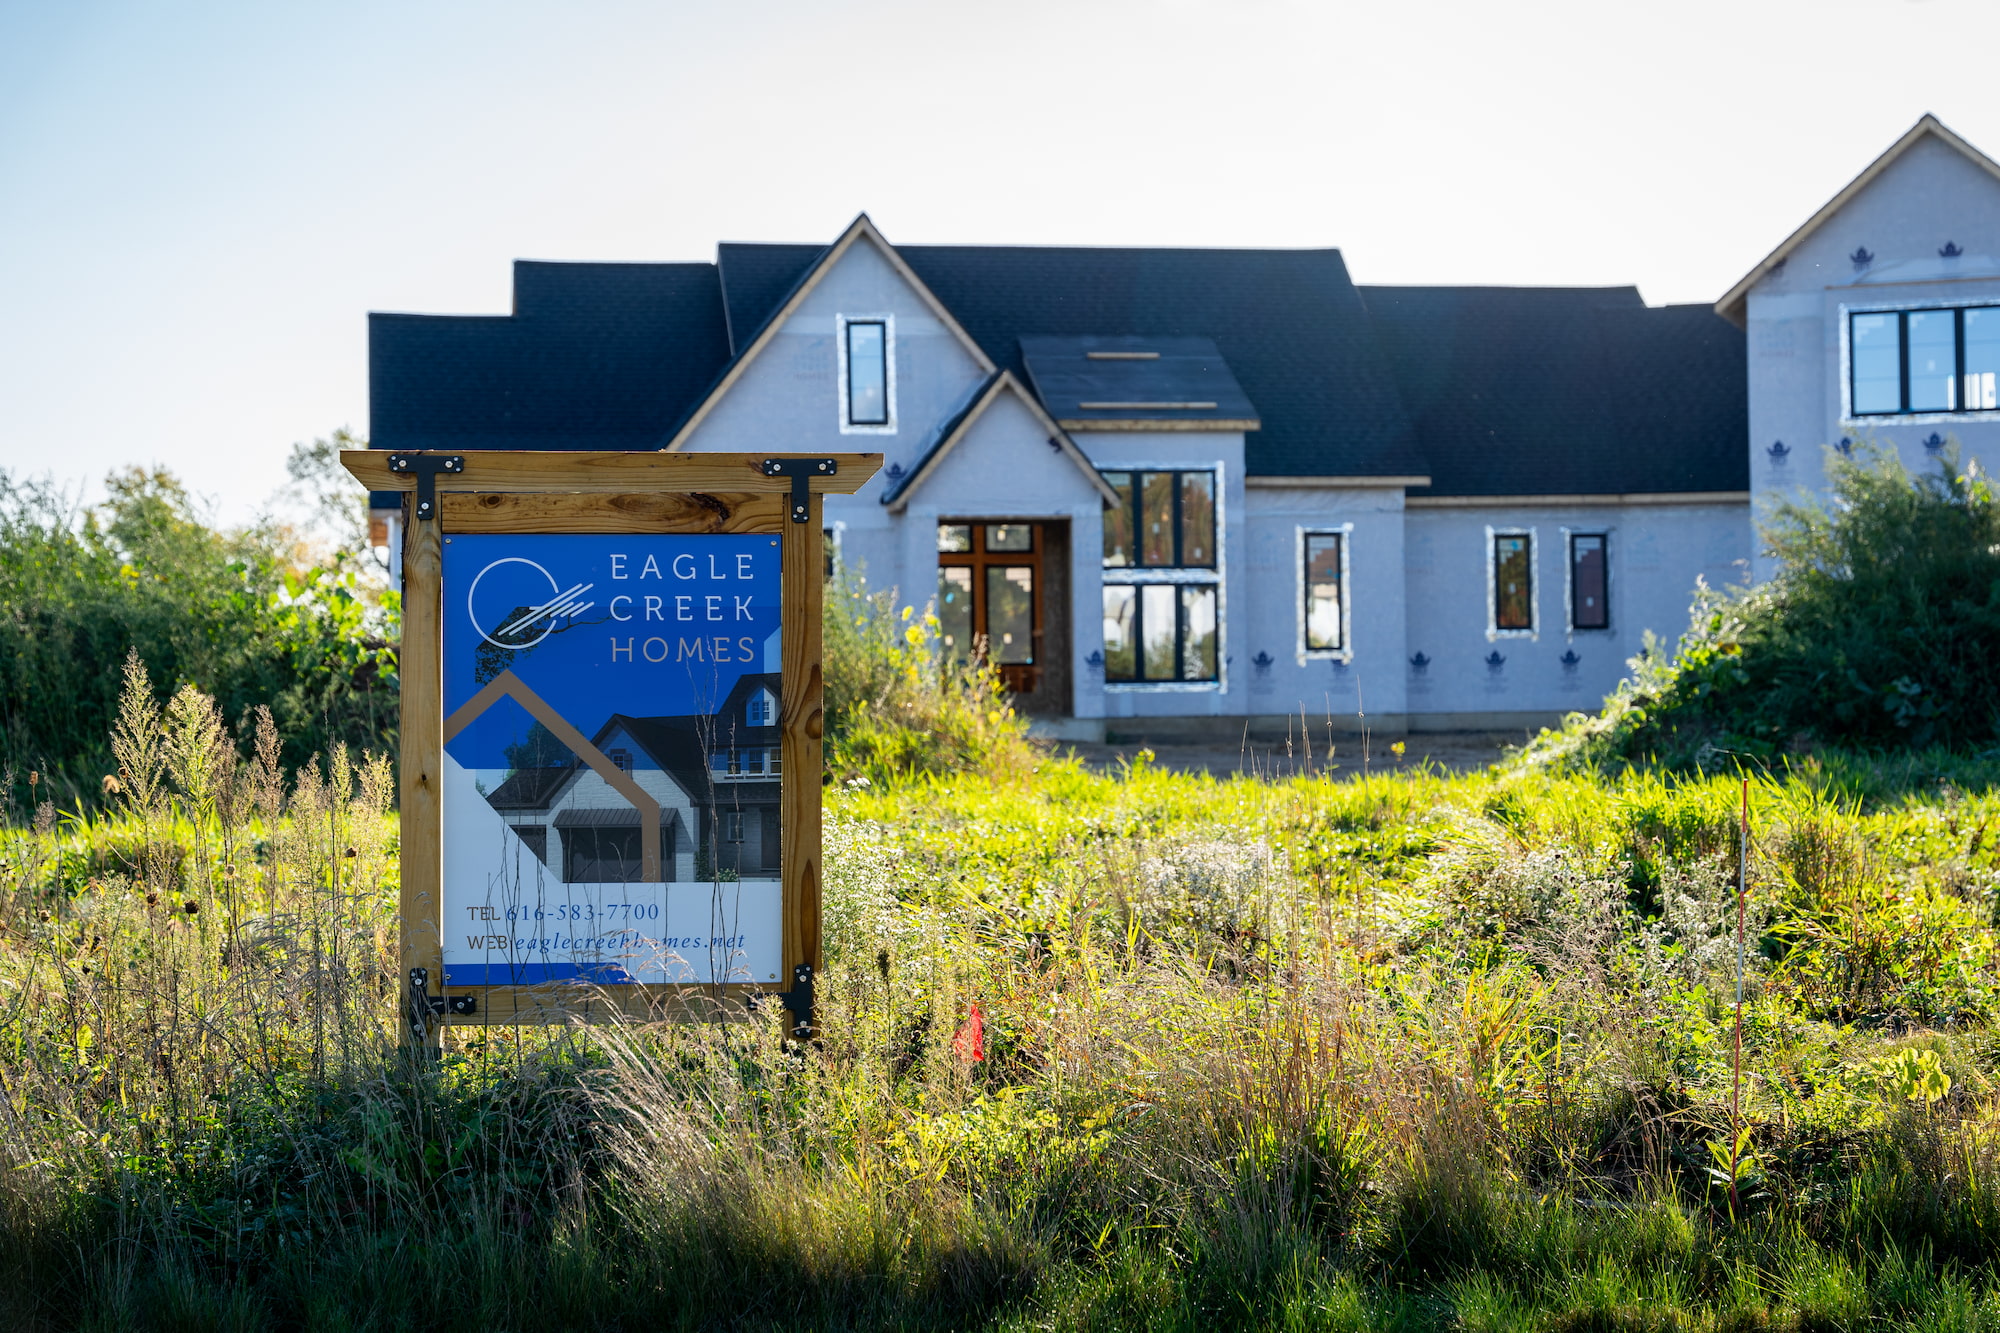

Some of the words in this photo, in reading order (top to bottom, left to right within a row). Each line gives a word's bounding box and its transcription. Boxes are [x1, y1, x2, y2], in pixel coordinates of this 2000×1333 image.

[609, 553, 754, 580] EAGLE
[609, 595, 754, 621] CREEK
[609, 636, 754, 663] HOMES
[466, 906, 501, 921] TEL
[506, 904, 659, 921] 616-583-7700
[466, 935, 508, 950] WEB
